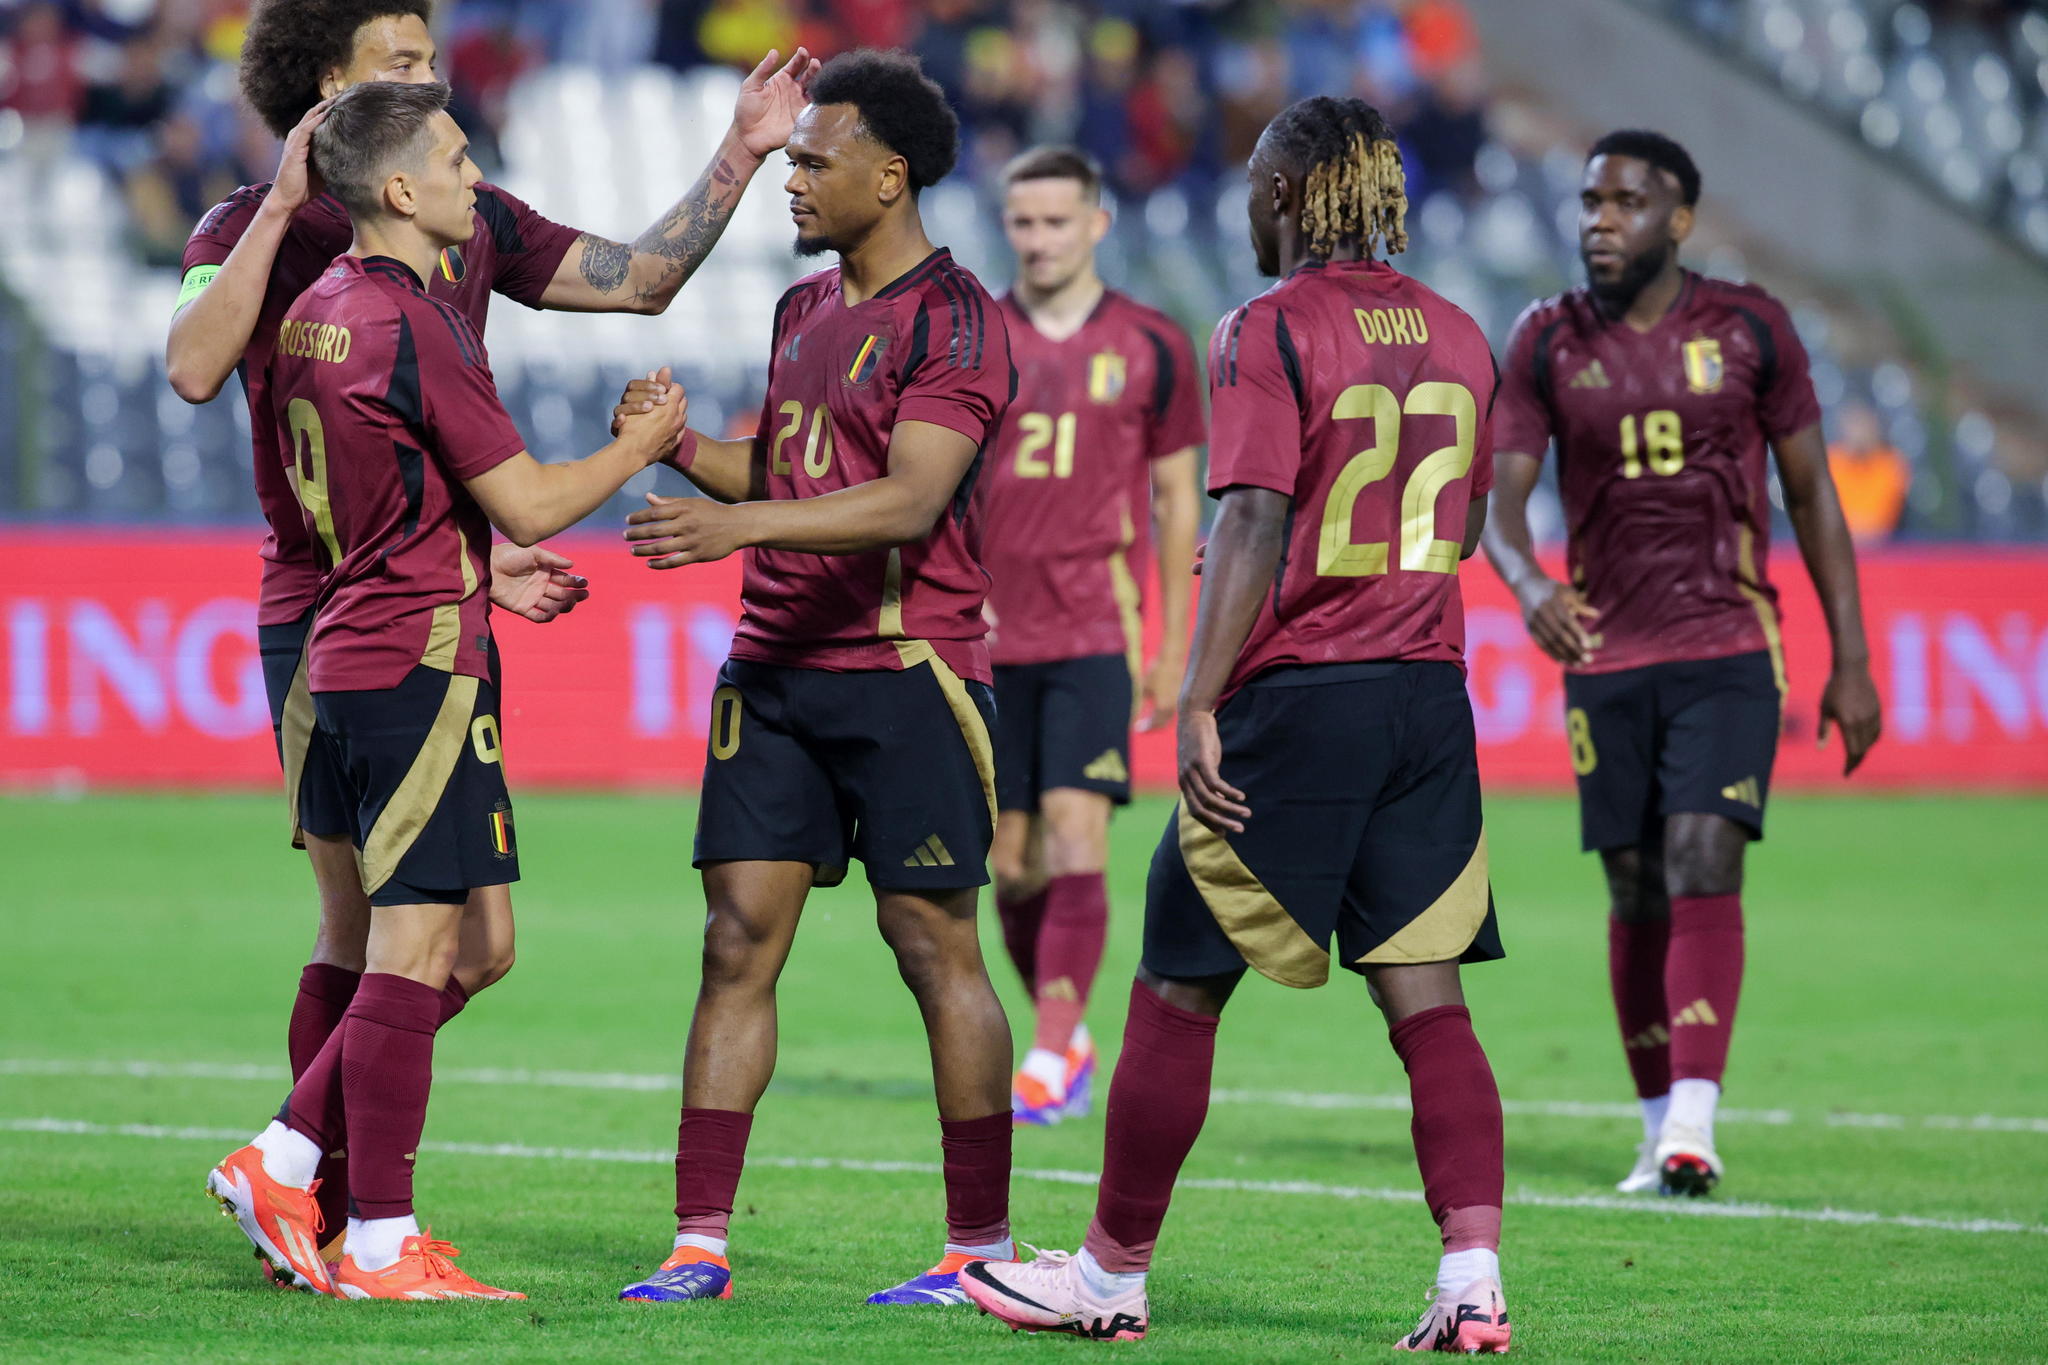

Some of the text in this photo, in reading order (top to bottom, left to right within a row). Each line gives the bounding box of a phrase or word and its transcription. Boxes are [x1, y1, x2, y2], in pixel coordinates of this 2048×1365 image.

[1354, 308, 1429, 344] DOKU
[288, 397, 344, 568] 9
[772, 399, 833, 478] 20
[1014, 412, 1077, 478] 21
[1316, 381, 1476, 577] 22
[1619, 410, 1685, 479] 18
[11, 598, 274, 739] ING
[1888, 610, 2048, 743] IN
